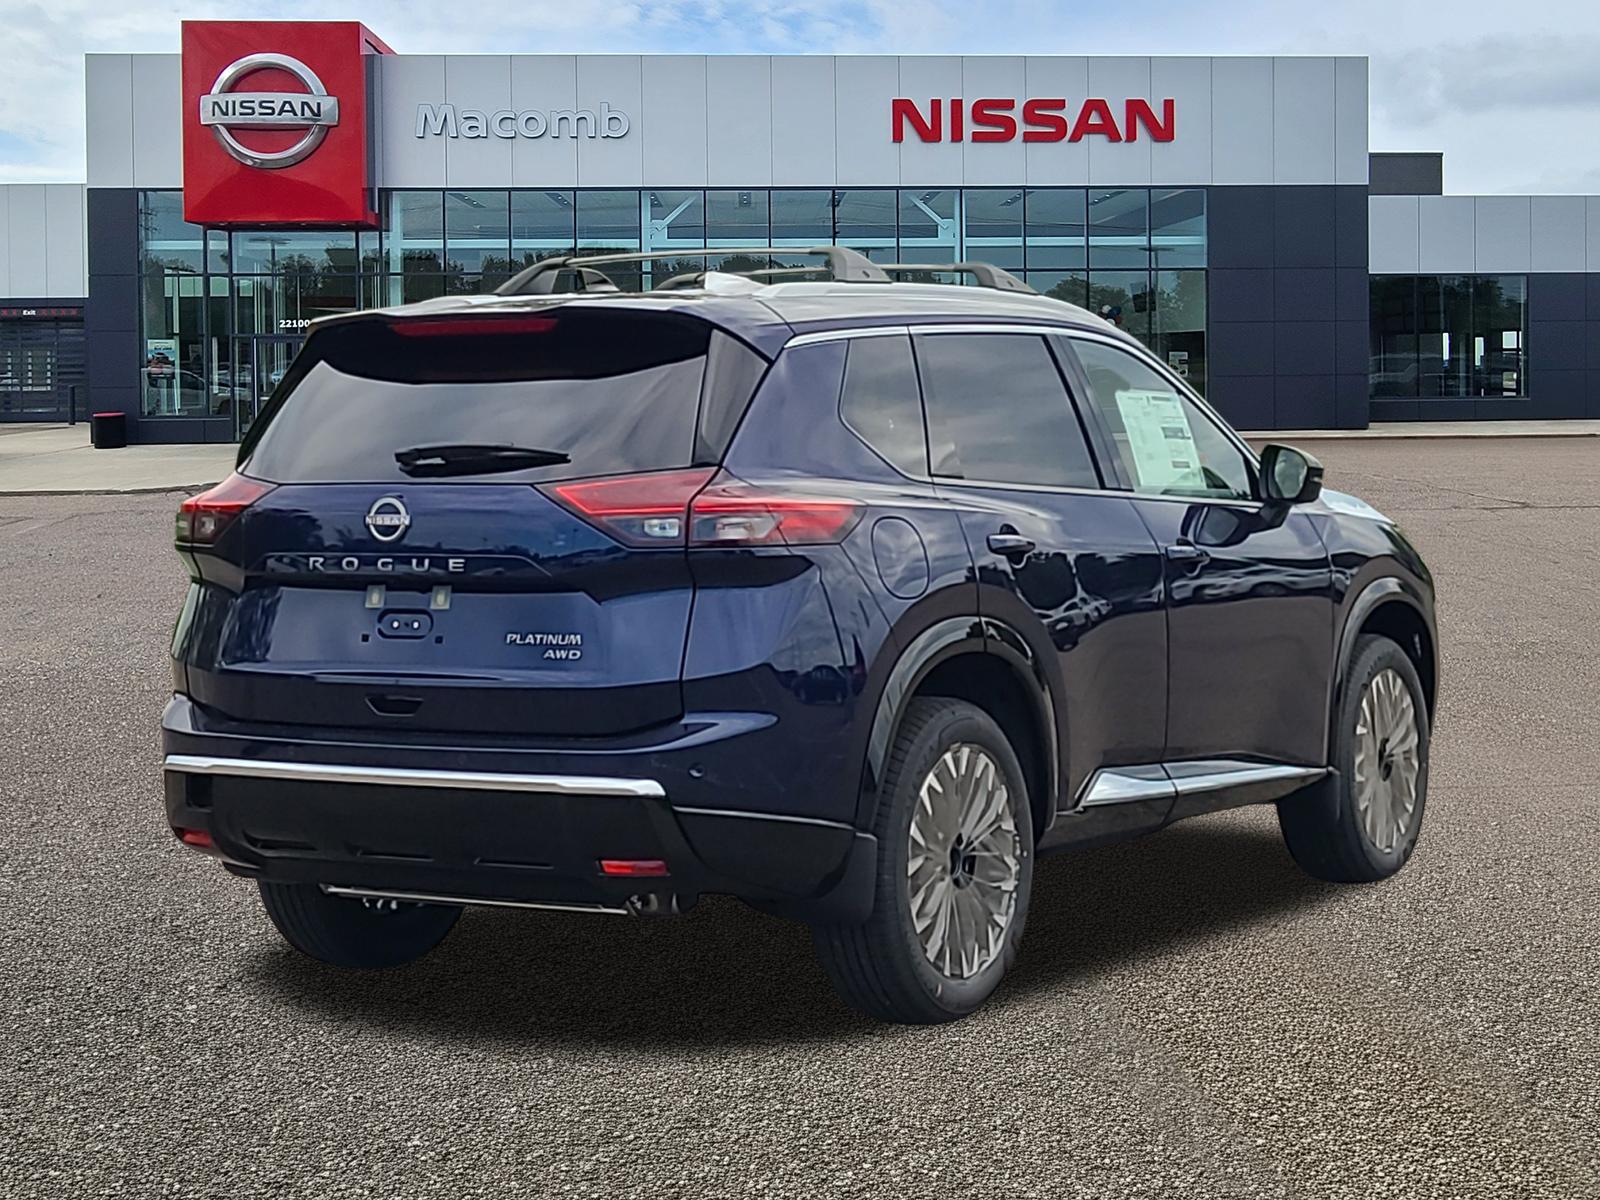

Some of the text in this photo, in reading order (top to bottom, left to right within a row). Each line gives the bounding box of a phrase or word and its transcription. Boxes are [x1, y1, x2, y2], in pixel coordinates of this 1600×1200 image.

[212, 99, 322, 118] NISSAN
[415, 101, 631, 139] Macomb
[892, 98, 1175, 143] NISSAN
[279, 319, 311, 328] 22100
[365, 513, 411, 527] NISSAN
[308, 556, 466, 573] ROGUE
[505, 633, 582, 646] PLATINUM
[543, 649, 582, 660] AWD
